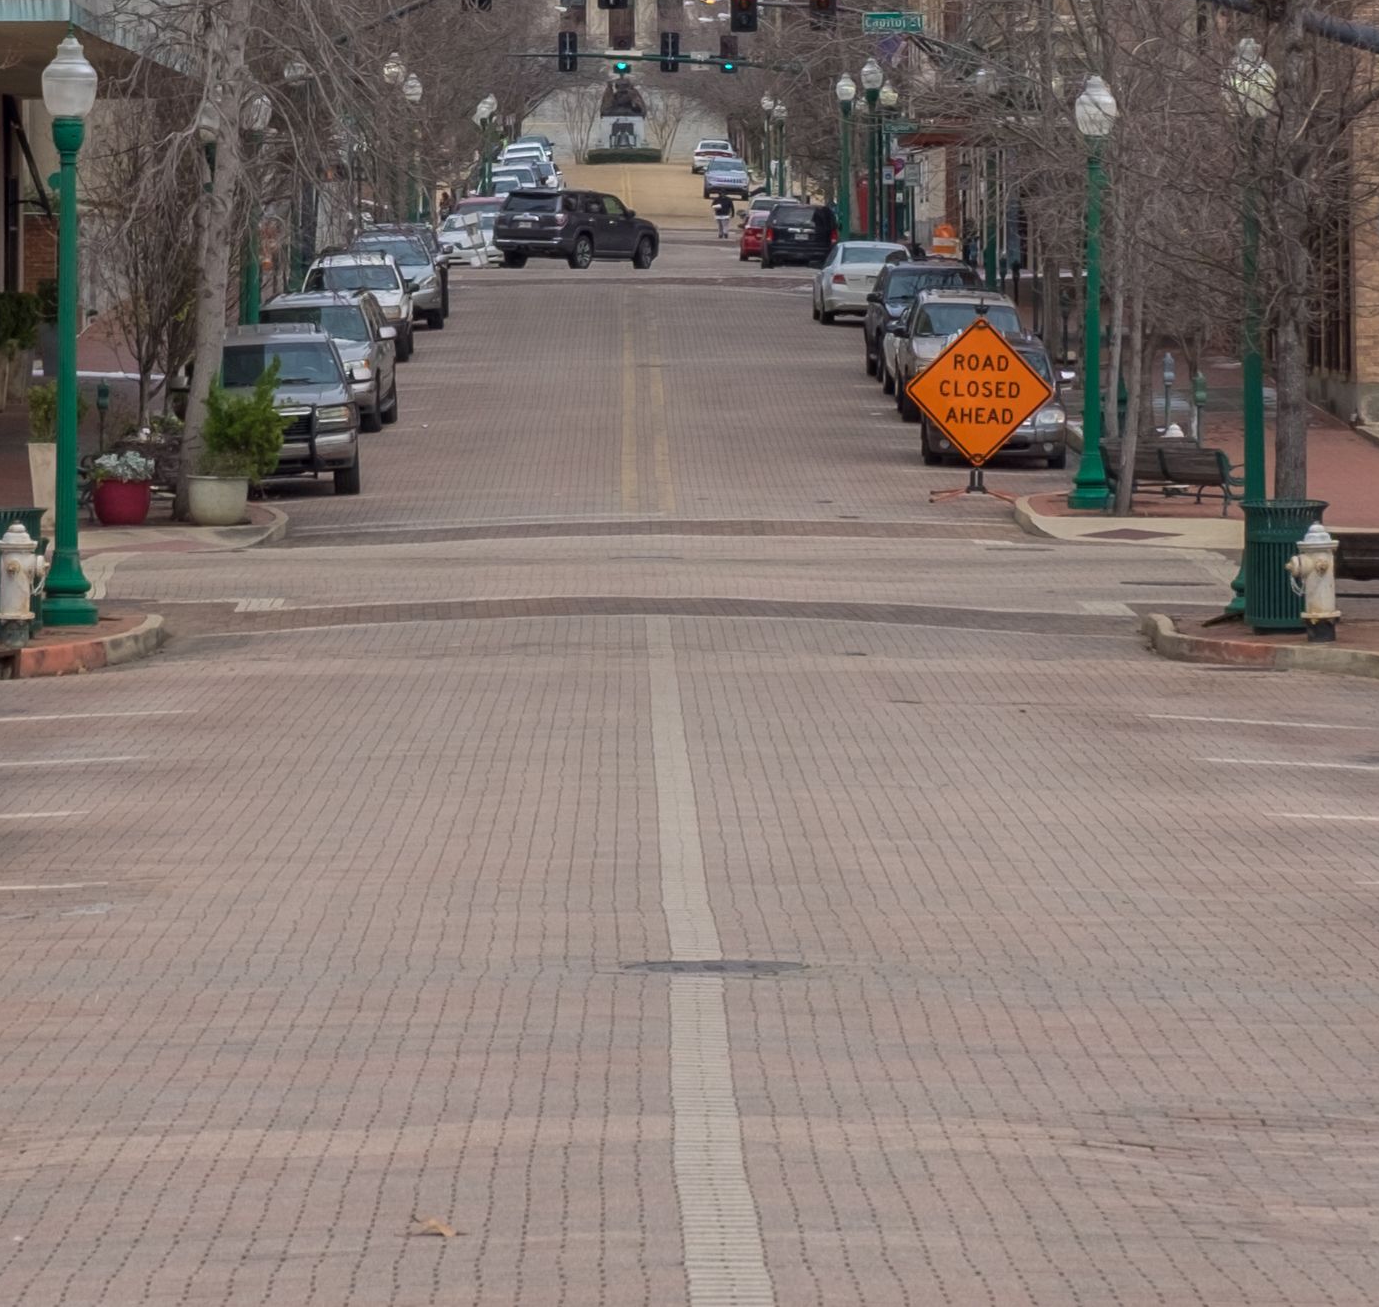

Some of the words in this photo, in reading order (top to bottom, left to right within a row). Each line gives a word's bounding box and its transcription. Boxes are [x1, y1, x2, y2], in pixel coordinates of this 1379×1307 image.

[865, 17, 906, 29] Capitol
[953, 354, 1009, 371] ROAD
[939, 380, 1020, 398] CLOSED
[945, 406, 1014, 425] AHEAD
